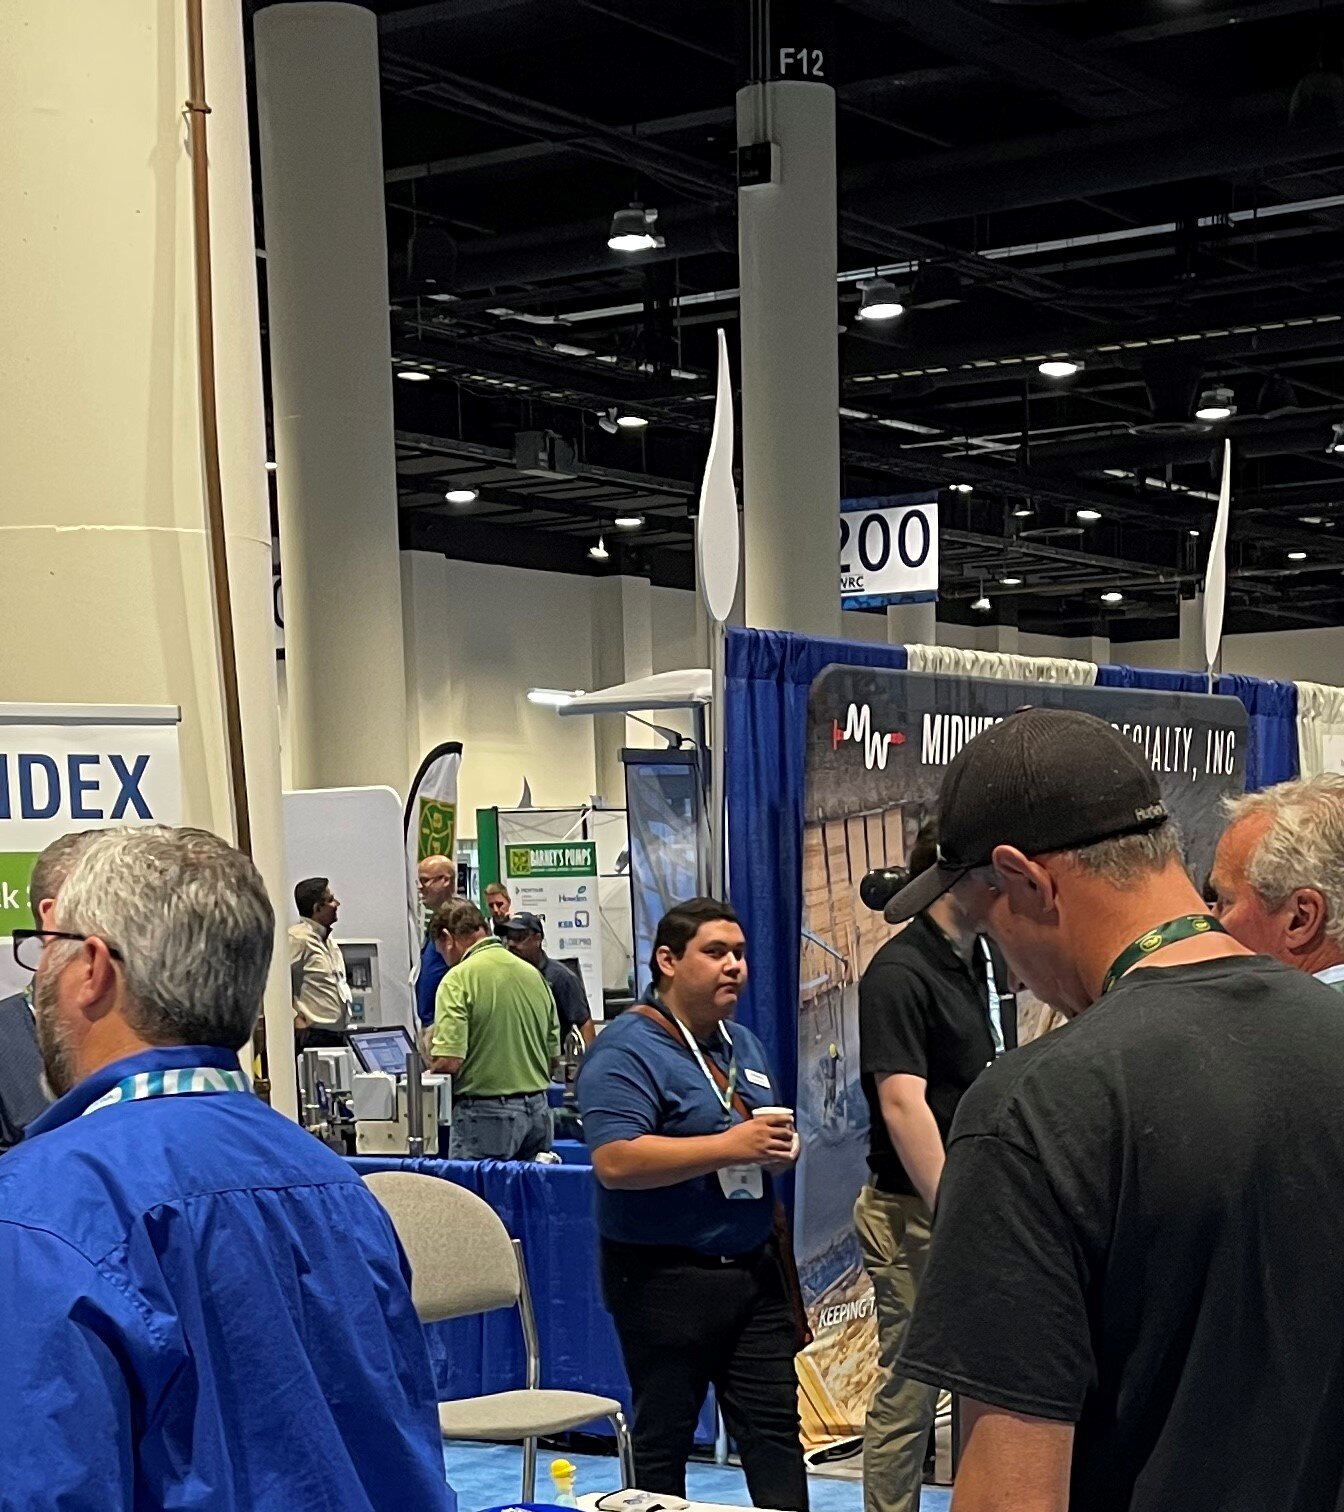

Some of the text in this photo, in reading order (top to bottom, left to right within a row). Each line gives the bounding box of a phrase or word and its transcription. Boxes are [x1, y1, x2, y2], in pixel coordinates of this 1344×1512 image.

[780, 48, 824, 77] F12
[1205, 729, 1235, 775] INC
[819, 1298, 867, 1329] KEEPING
